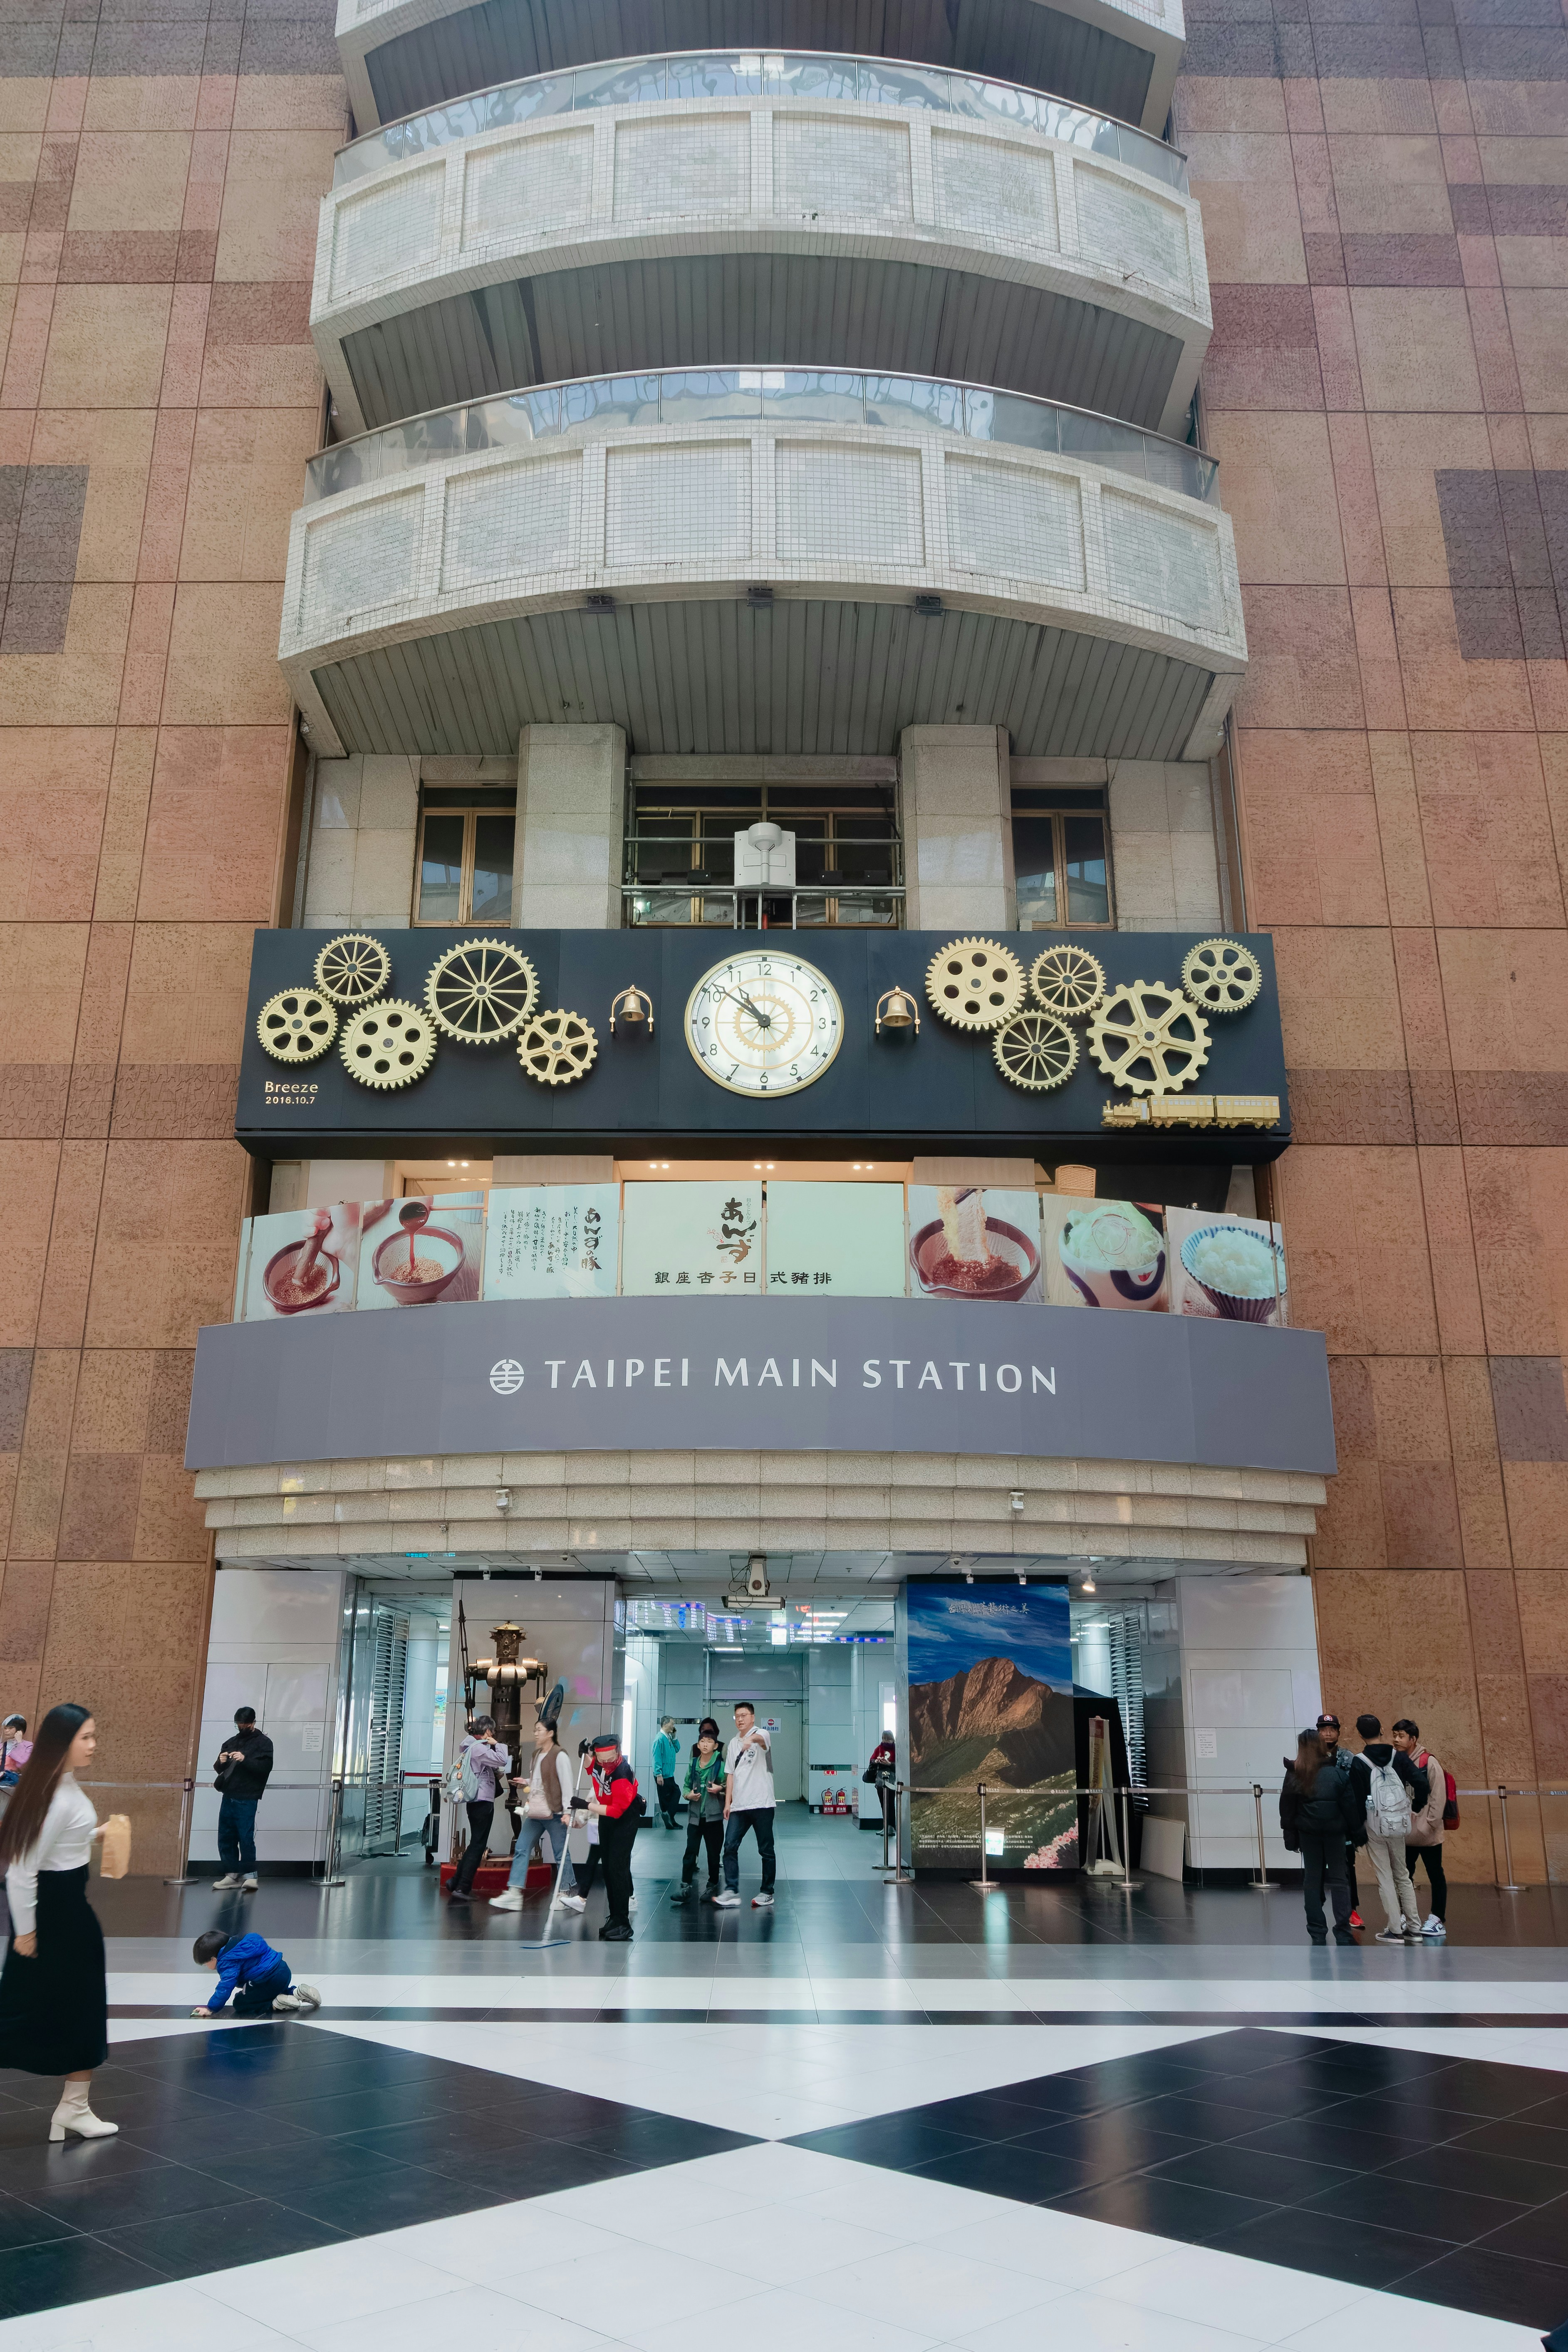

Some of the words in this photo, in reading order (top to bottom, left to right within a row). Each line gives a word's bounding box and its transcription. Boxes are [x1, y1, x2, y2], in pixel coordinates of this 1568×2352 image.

[758, 964, 771, 975] 12
[729, 971, 741, 982] 11
[790, 971, 795, 982] 1
[707, 991, 721, 1003] 10
[810, 990, 818, 1002] 2
[702, 1017, 710, 1029] 9
[819, 1018, 826, 1029] 3
[710, 1044, 717, 1055] 8
[810, 1045, 819, 1056] 4
[731, 1064, 740, 1077] 7
[790, 1064, 798, 1076] 5
[760, 1072, 768, 1083] 6
[265, 1081, 318, 1093] Breeze
[716, 1197, 757, 1264] あんず
[581, 1207, 602, 1271] あんずの豚
[654, 1271, 832, 1285] 銀座杏子日式豬排
[545, 1358, 689, 1388] TAIPEI
[714, 1358, 836, 1387] MAIN
[862, 1359, 1056, 1394] STATION
